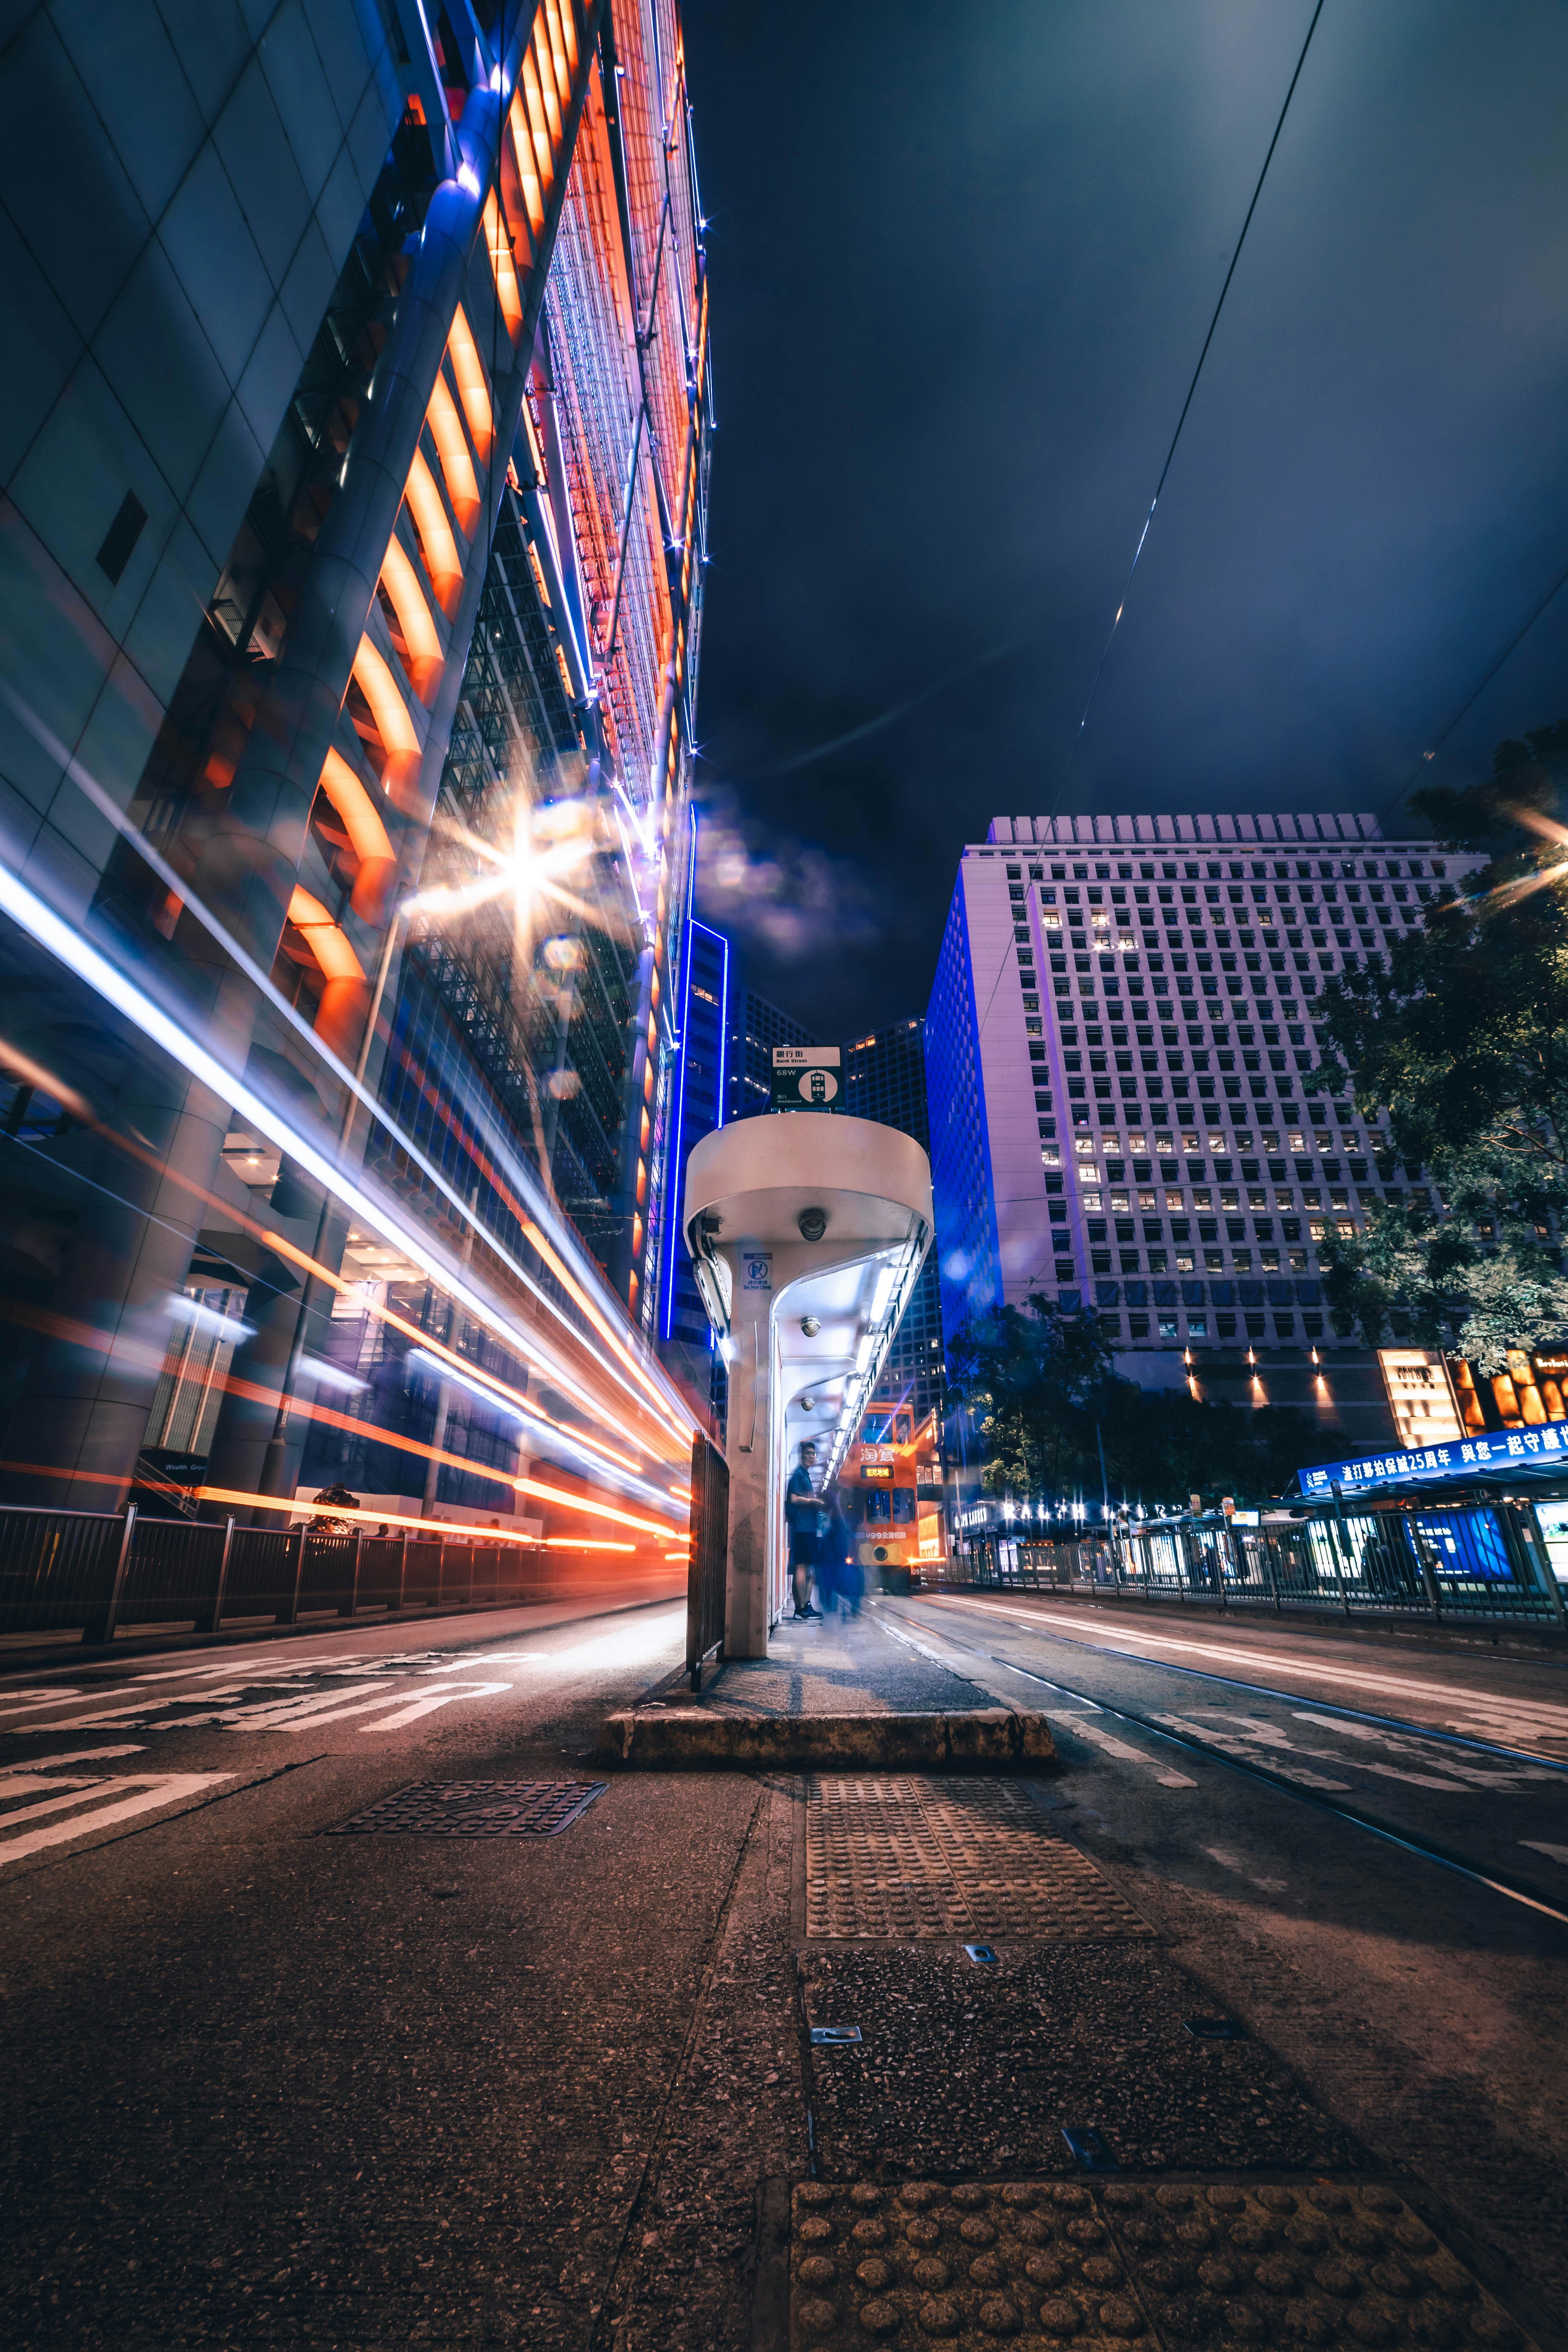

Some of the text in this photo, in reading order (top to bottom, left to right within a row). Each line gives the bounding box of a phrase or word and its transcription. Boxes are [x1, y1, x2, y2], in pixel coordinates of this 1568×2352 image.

[860, 1448, 895, 1462] 淘寶
[867, 1468, 889, 1477] 堅尼地城
